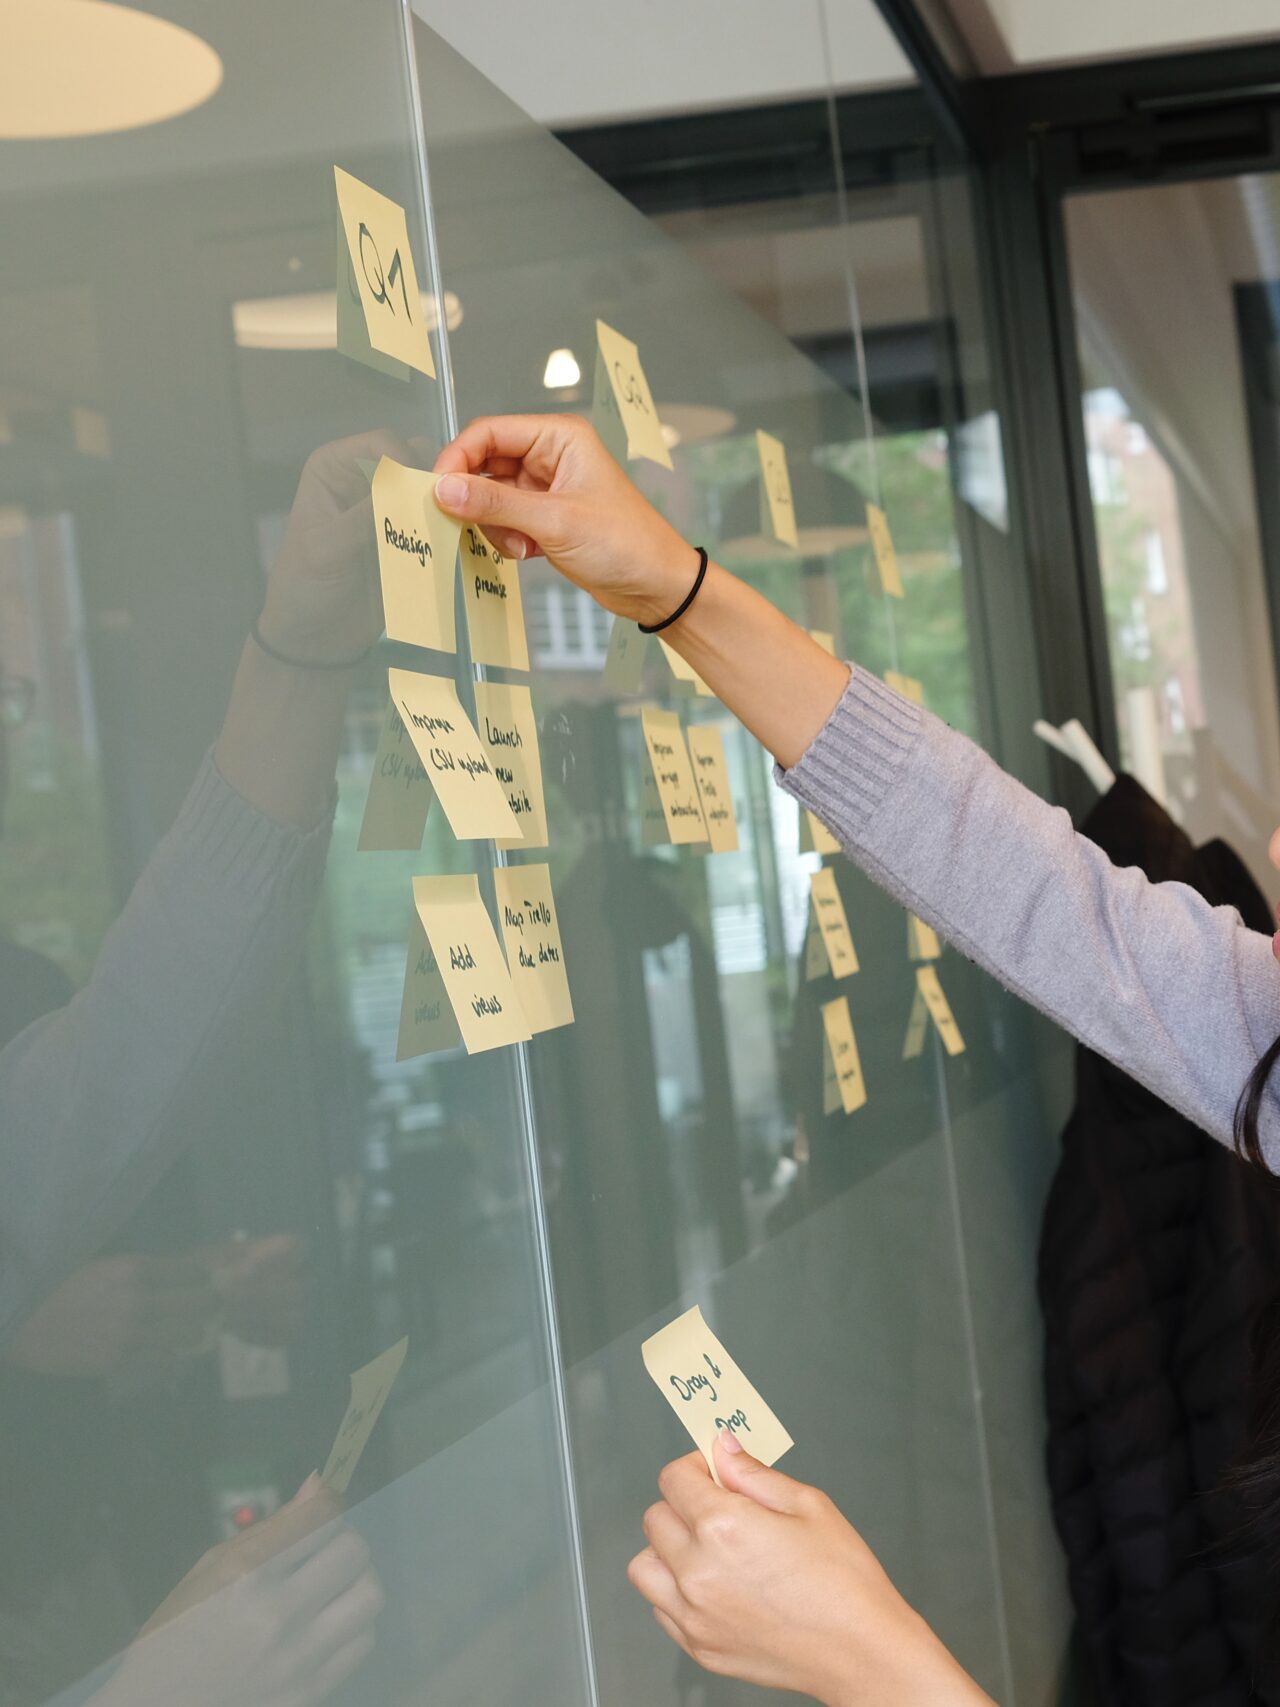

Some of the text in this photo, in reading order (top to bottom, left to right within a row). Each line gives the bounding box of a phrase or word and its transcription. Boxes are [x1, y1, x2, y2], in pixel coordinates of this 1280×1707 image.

[358, 222, 414, 327] Q1
[384, 516, 432, 567] Redesign
[475, 575, 507, 599] premise
[401, 700, 455, 740] Improve
[485, 716, 523, 748] Launch
[430, 748, 455, 771] CSV
[457, 753, 492, 781] upload
[495, 767, 513, 783] new
[505, 900, 551, 936] Map Trello
[449, 943, 477, 971] Add
[518, 942, 560, 968] due dates
[471, 994, 503, 1018] views
[670, 1353, 722, 1402] Drag &
